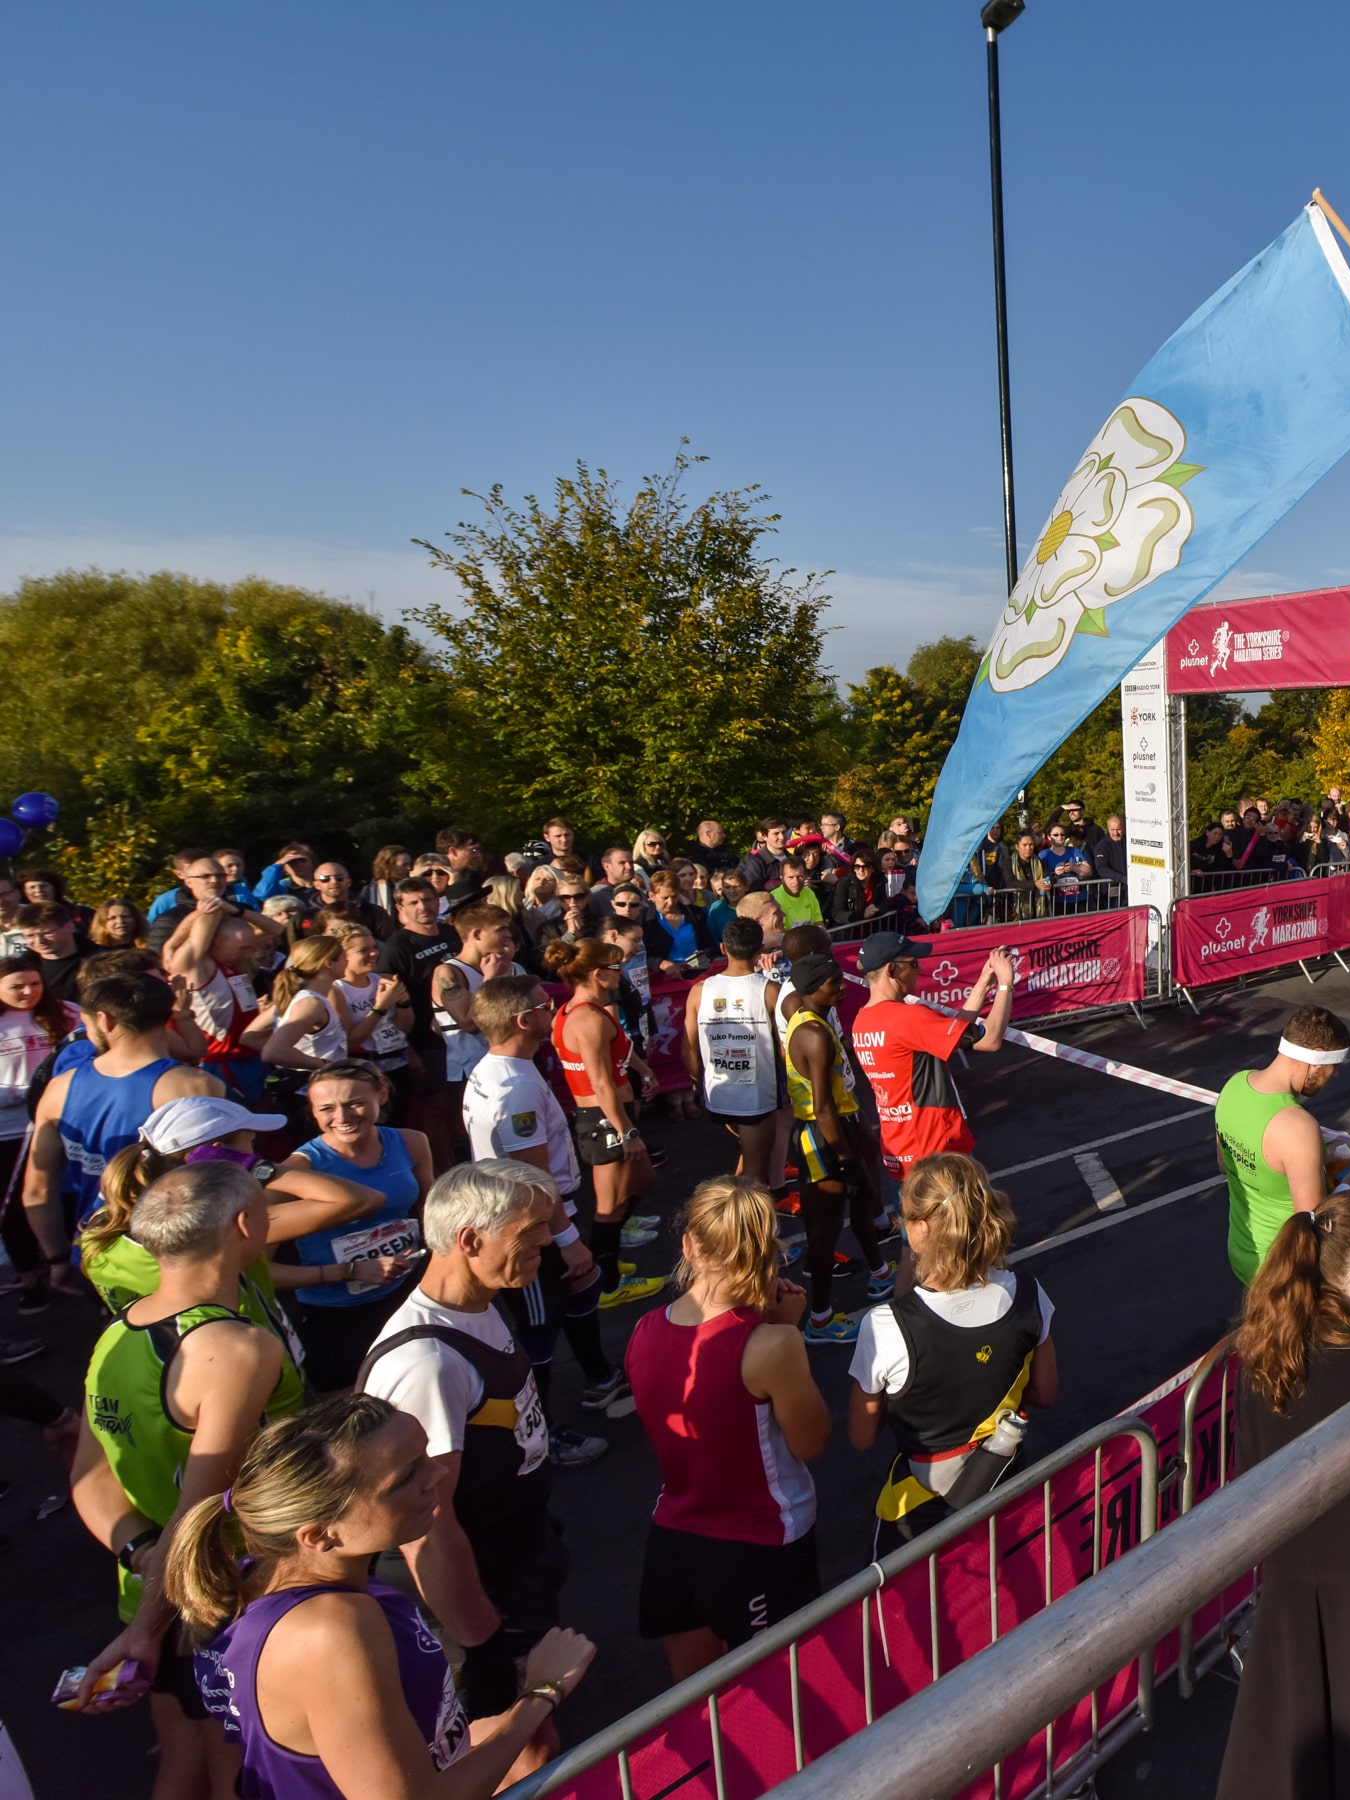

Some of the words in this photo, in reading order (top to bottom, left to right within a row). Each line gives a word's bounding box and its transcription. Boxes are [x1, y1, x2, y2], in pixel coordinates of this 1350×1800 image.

[1234, 633, 1246, 649] THE
[1246, 629, 1282, 648] YORKSHIRE
[1180, 655, 1208, 670] plusnet
[1234, 648, 1262, 662] MARATHON
[1263, 646, 1282, 660] SERIES
[1138, 713, 1156, 721] YORK
[1133, 752, 1156, 762] plusnet
[1272, 901, 1317, 925] YORKSHIRE
[1272, 919, 1317, 945] MARATHON
[415, 942, 448, 960] GREG
[1028, 938, 1100, 969] YORKSHIRE
[1201, 935, 1245, 959] plusnet
[1028, 960, 1100, 991] MARATHON
[921, 988, 974, 1004] lusne
[714, 1059, 751, 1071] PACER
[857, 1051, 876, 1066] ME!
[1224, 1132, 1256, 1161] wakefield
[1224, 1140, 1256, 1171] hospice
[88, 1394, 118, 1413] TEAM
